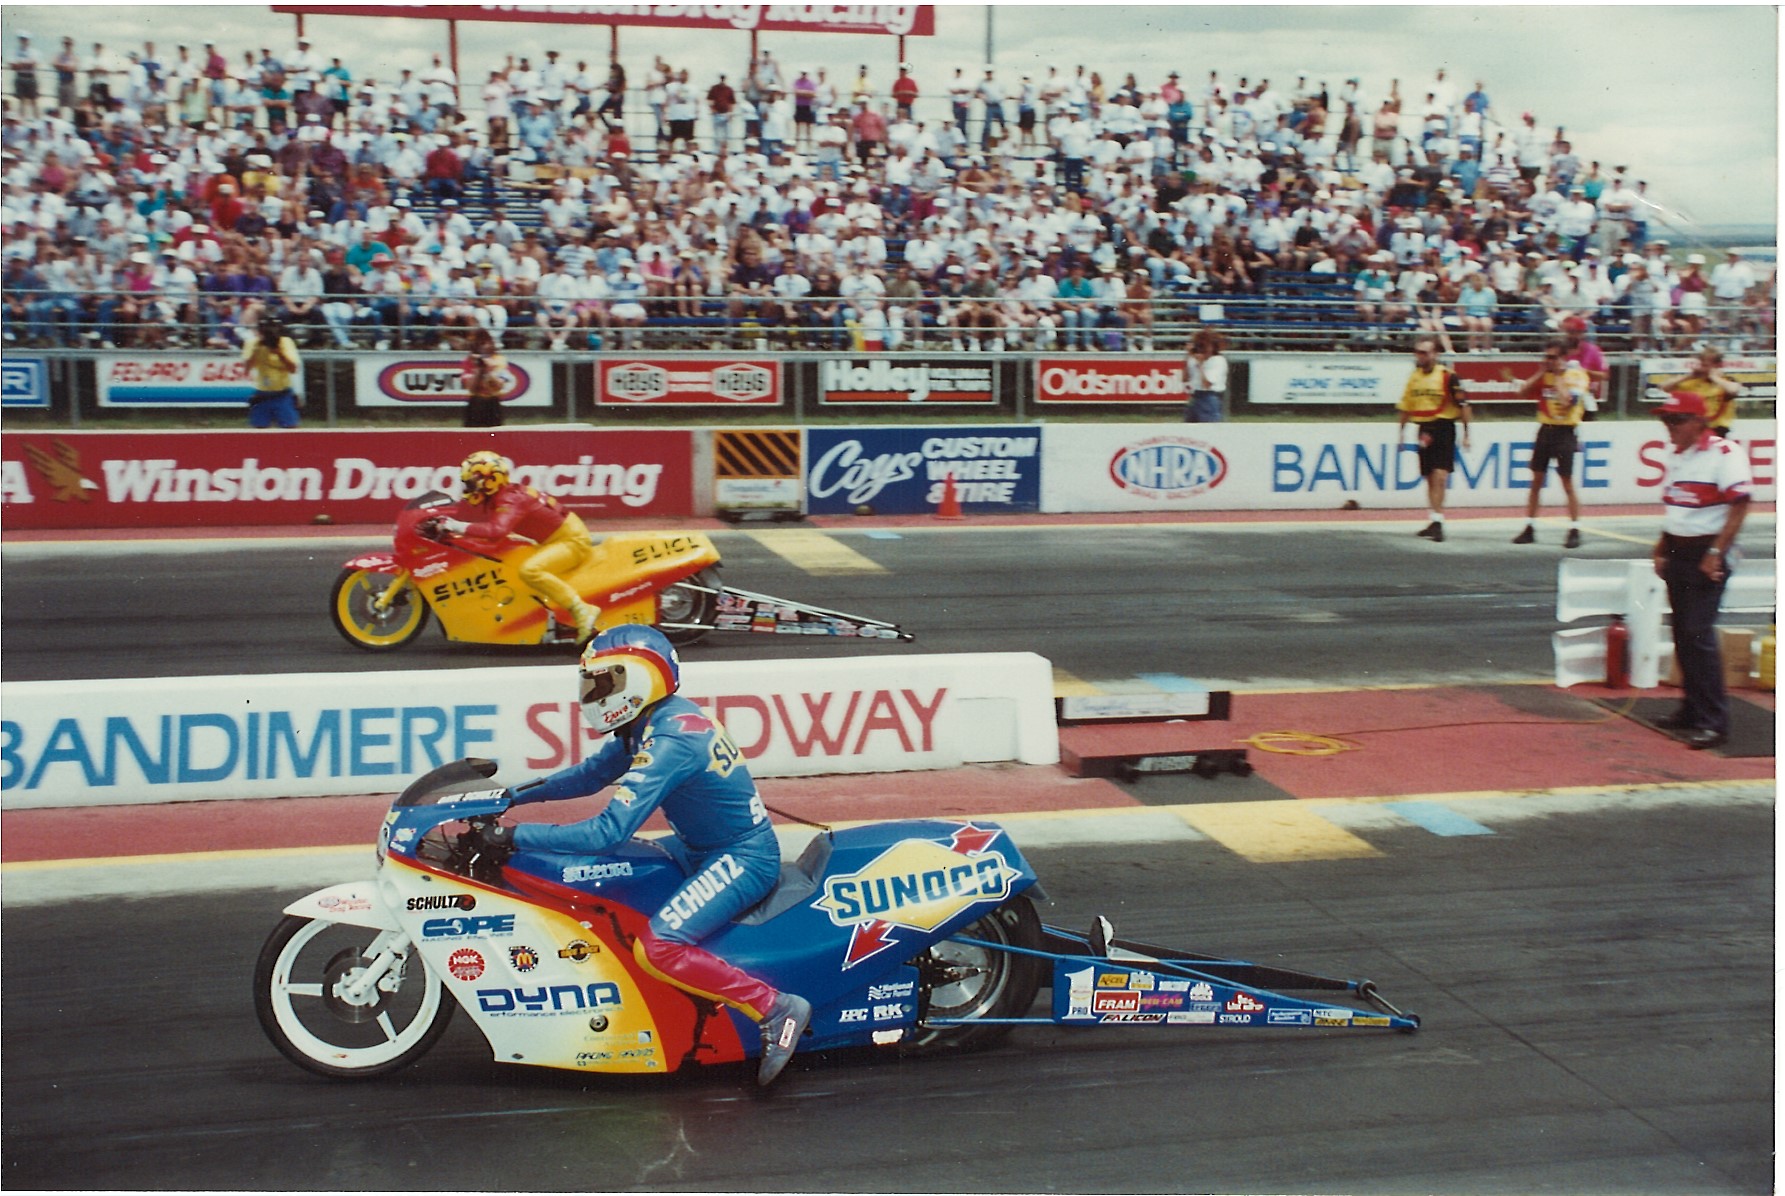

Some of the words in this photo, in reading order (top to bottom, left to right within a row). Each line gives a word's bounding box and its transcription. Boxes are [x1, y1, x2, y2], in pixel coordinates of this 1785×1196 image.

[823, 360, 930, 401] Holley
[921, 437, 1039, 459] CUSTOM
[926, 459, 1022, 481] WHEEL
[1126, 446, 1212, 488] NHRA
[102, 458, 323, 503] Winston
[507, 455, 663, 507] acing
[955, 482, 1017, 504] TIRE
[562, 862, 634, 882] SUZUKI
[660, 854, 745, 931] SCHULTZ
[832, 858, 1004, 919] SUNOCO
[407, 895, 461, 911] SCHULTZ
[422, 914, 516, 937] COPE
[453, 955, 479, 964] NGK
[476, 982, 621, 1011] DYNA
[1098, 999, 1136, 1010] FRAM
[873, 1003, 903, 1019] RK
[1072, 1007, 1088, 1015] PRO
[1103, 1013, 1163, 1022] FALICON
[1219, 1014, 1251, 1023] STROUD
